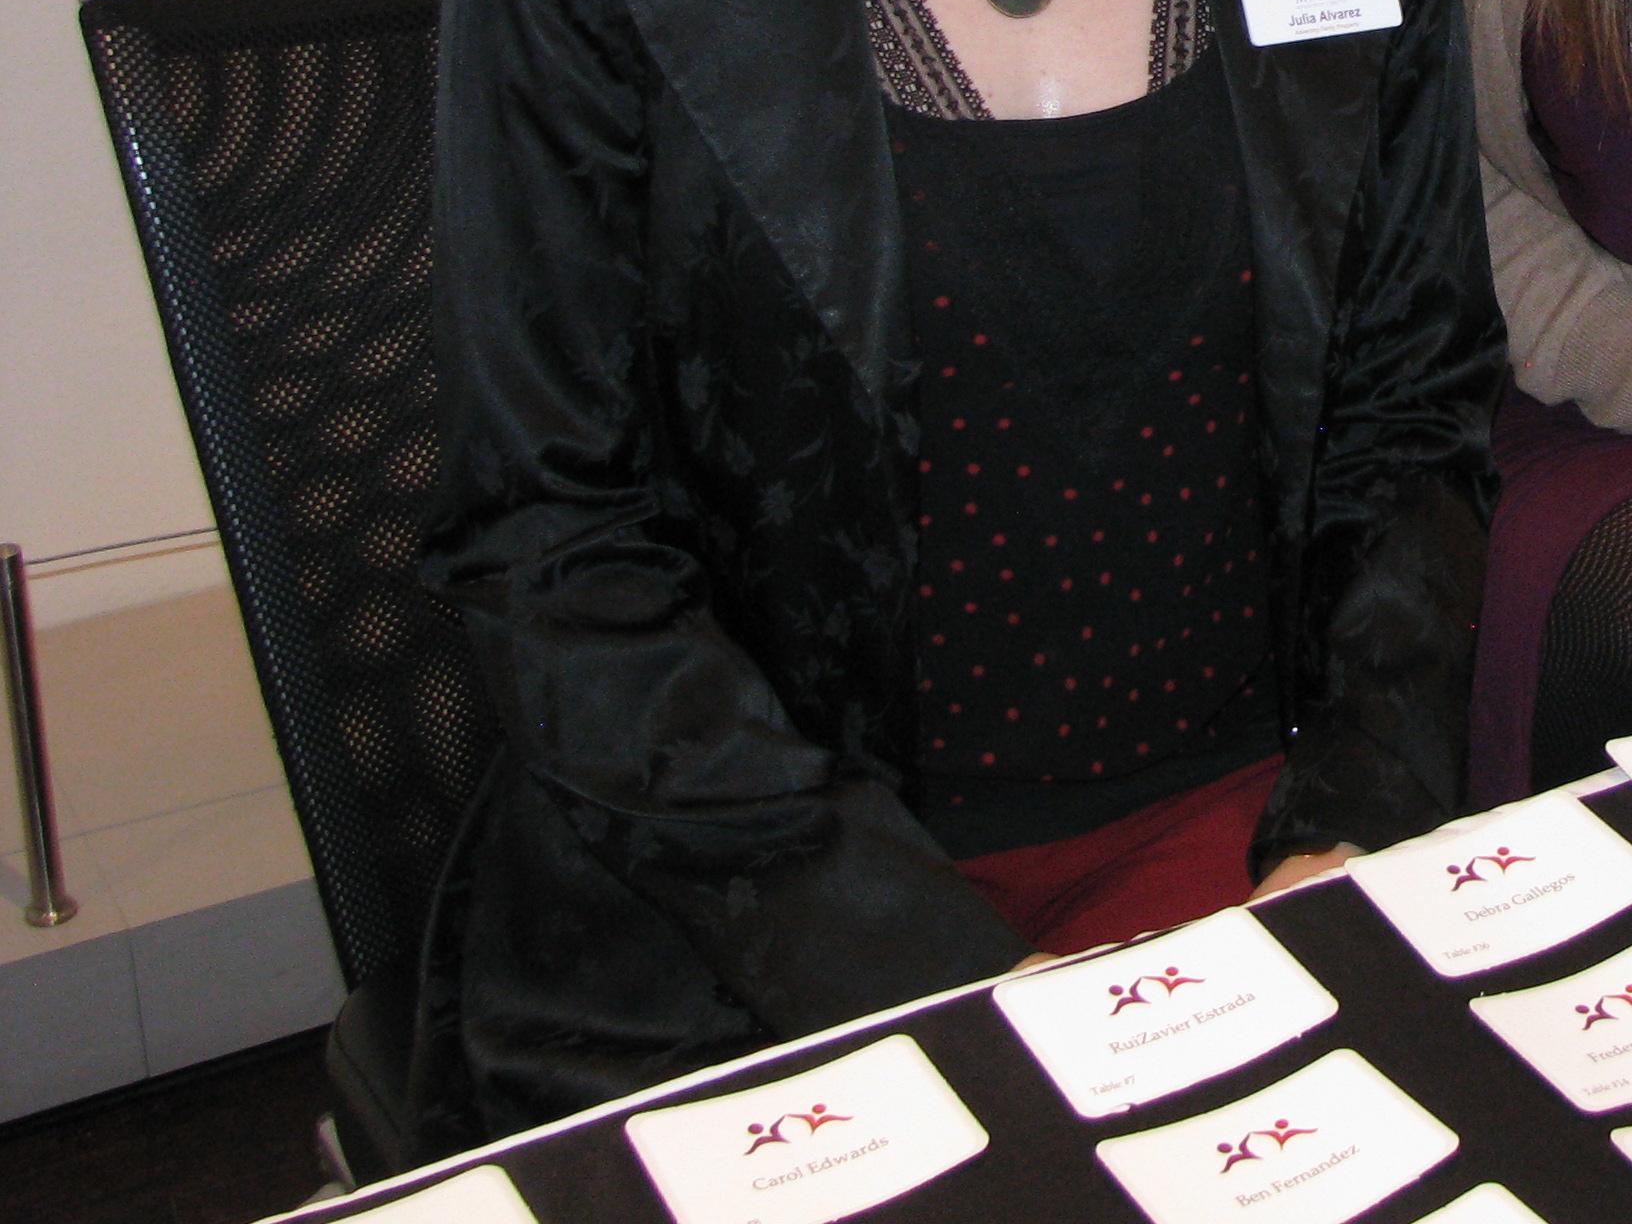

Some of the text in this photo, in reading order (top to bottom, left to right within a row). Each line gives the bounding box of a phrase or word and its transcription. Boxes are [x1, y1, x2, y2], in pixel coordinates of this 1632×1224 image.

[1289, 8, 1362, 27] Julia Alvarez
[1463, 872, 1577, 923] Debra Gallegos
[1108, 991, 1257, 1055] RuiZavier Estrada
[752, 1135, 890, 1192] Carol Edwards
[1235, 1144, 1361, 1208] Ben Fernandez
